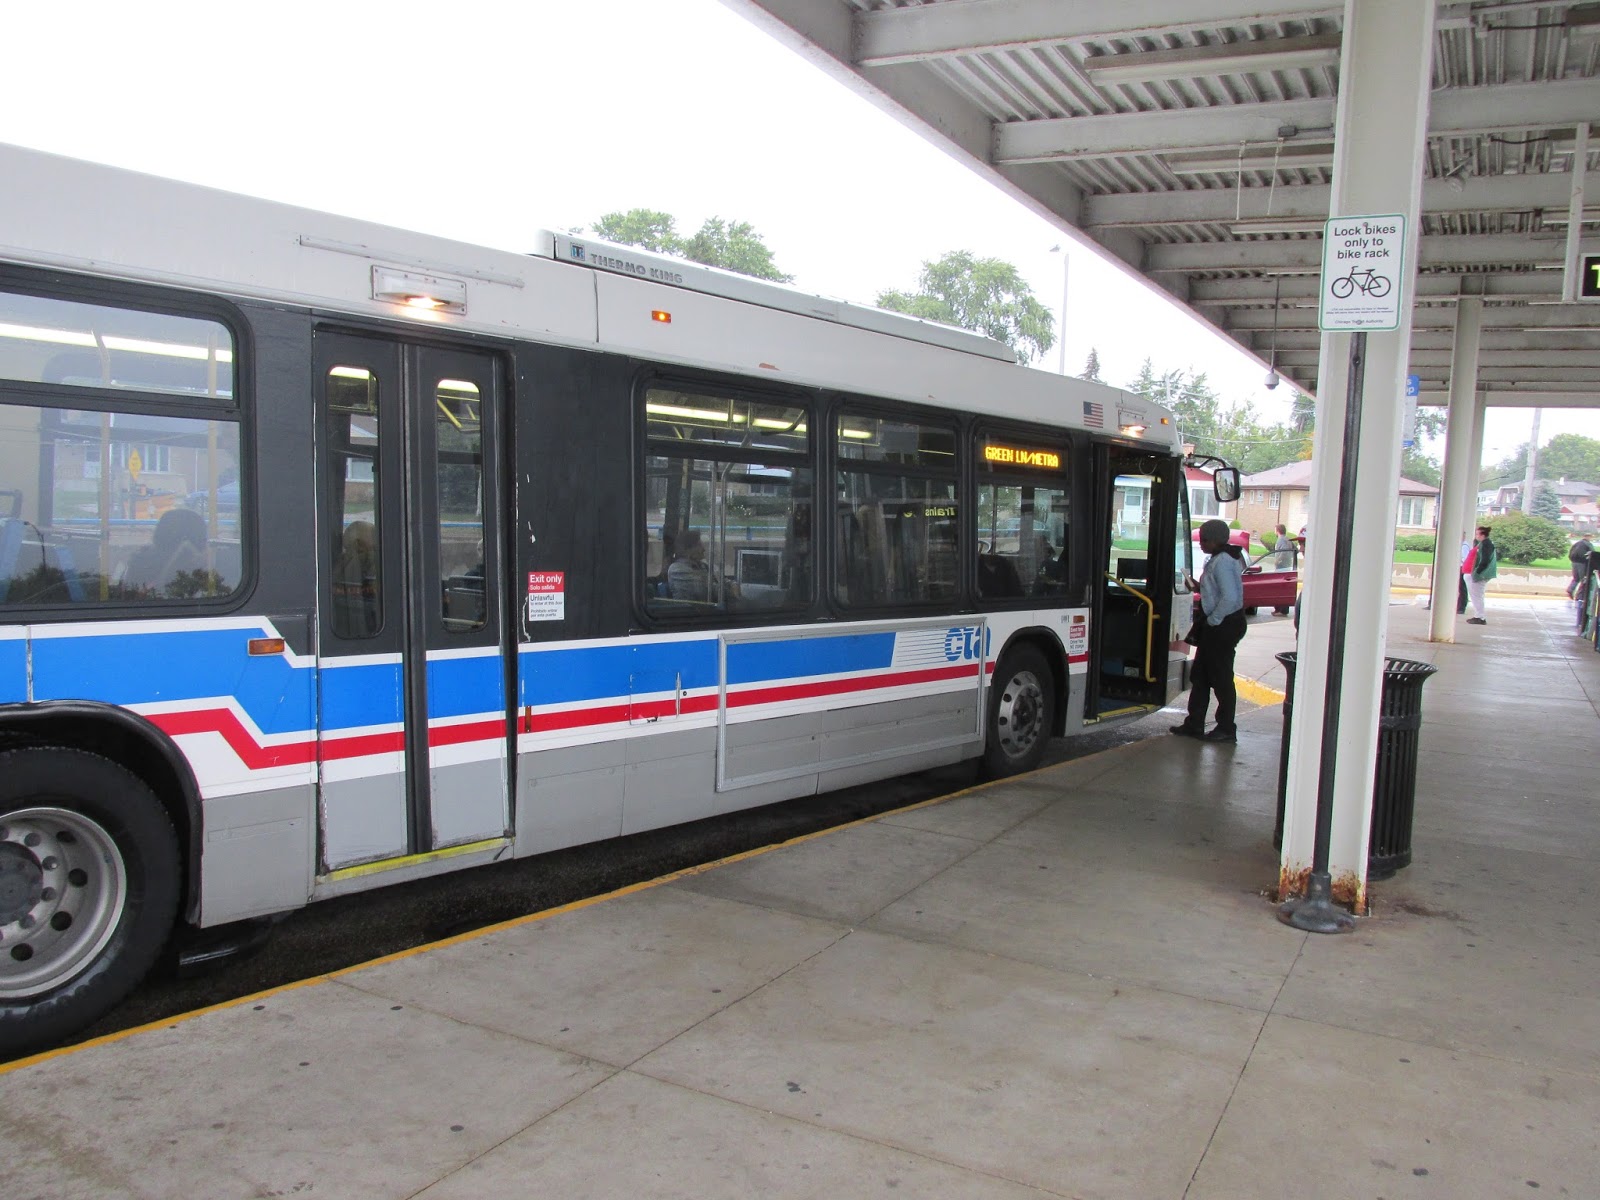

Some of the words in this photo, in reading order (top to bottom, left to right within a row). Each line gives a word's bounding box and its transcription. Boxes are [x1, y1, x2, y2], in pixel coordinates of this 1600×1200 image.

[1334, 226, 1361, 236] Lock
[1365, 224, 1396, 235] bikes
[1344, 238, 1369, 249] only
[1372, 238, 1383, 246] to
[1337, 250, 1361, 259] bike
[1364, 248, 1389, 258] rack
[590, 253, 646, 275] THERMO
[650, 267, 683, 284] KING
[985, 446, 1014, 462] GREEN
[530, 574, 545, 583] Exit
[546, 573, 563, 584] only
